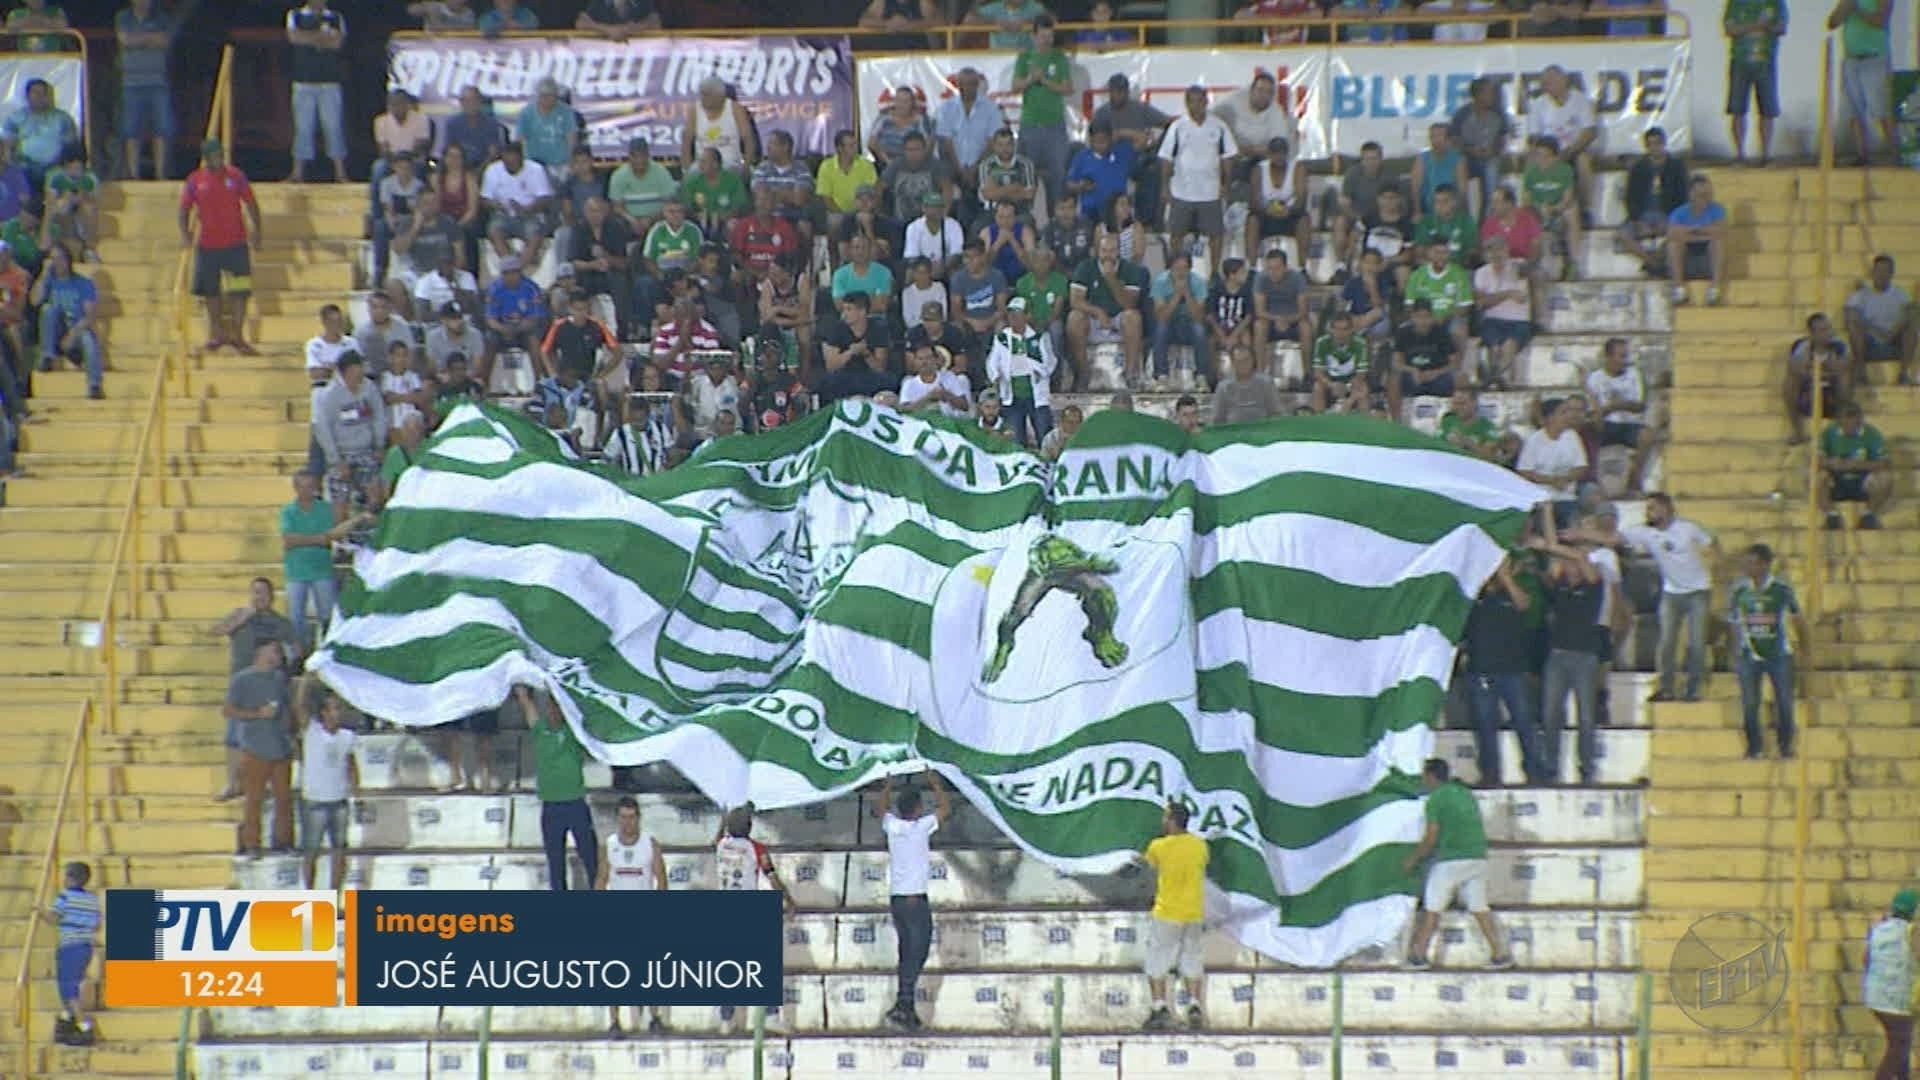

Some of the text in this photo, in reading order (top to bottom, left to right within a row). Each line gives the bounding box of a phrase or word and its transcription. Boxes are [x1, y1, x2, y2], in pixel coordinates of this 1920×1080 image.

[662, 44, 838, 97] IMPORTS
[1331, 68, 1668, 119] BLUETRDE
[1041, 757, 1164, 808] NADA
